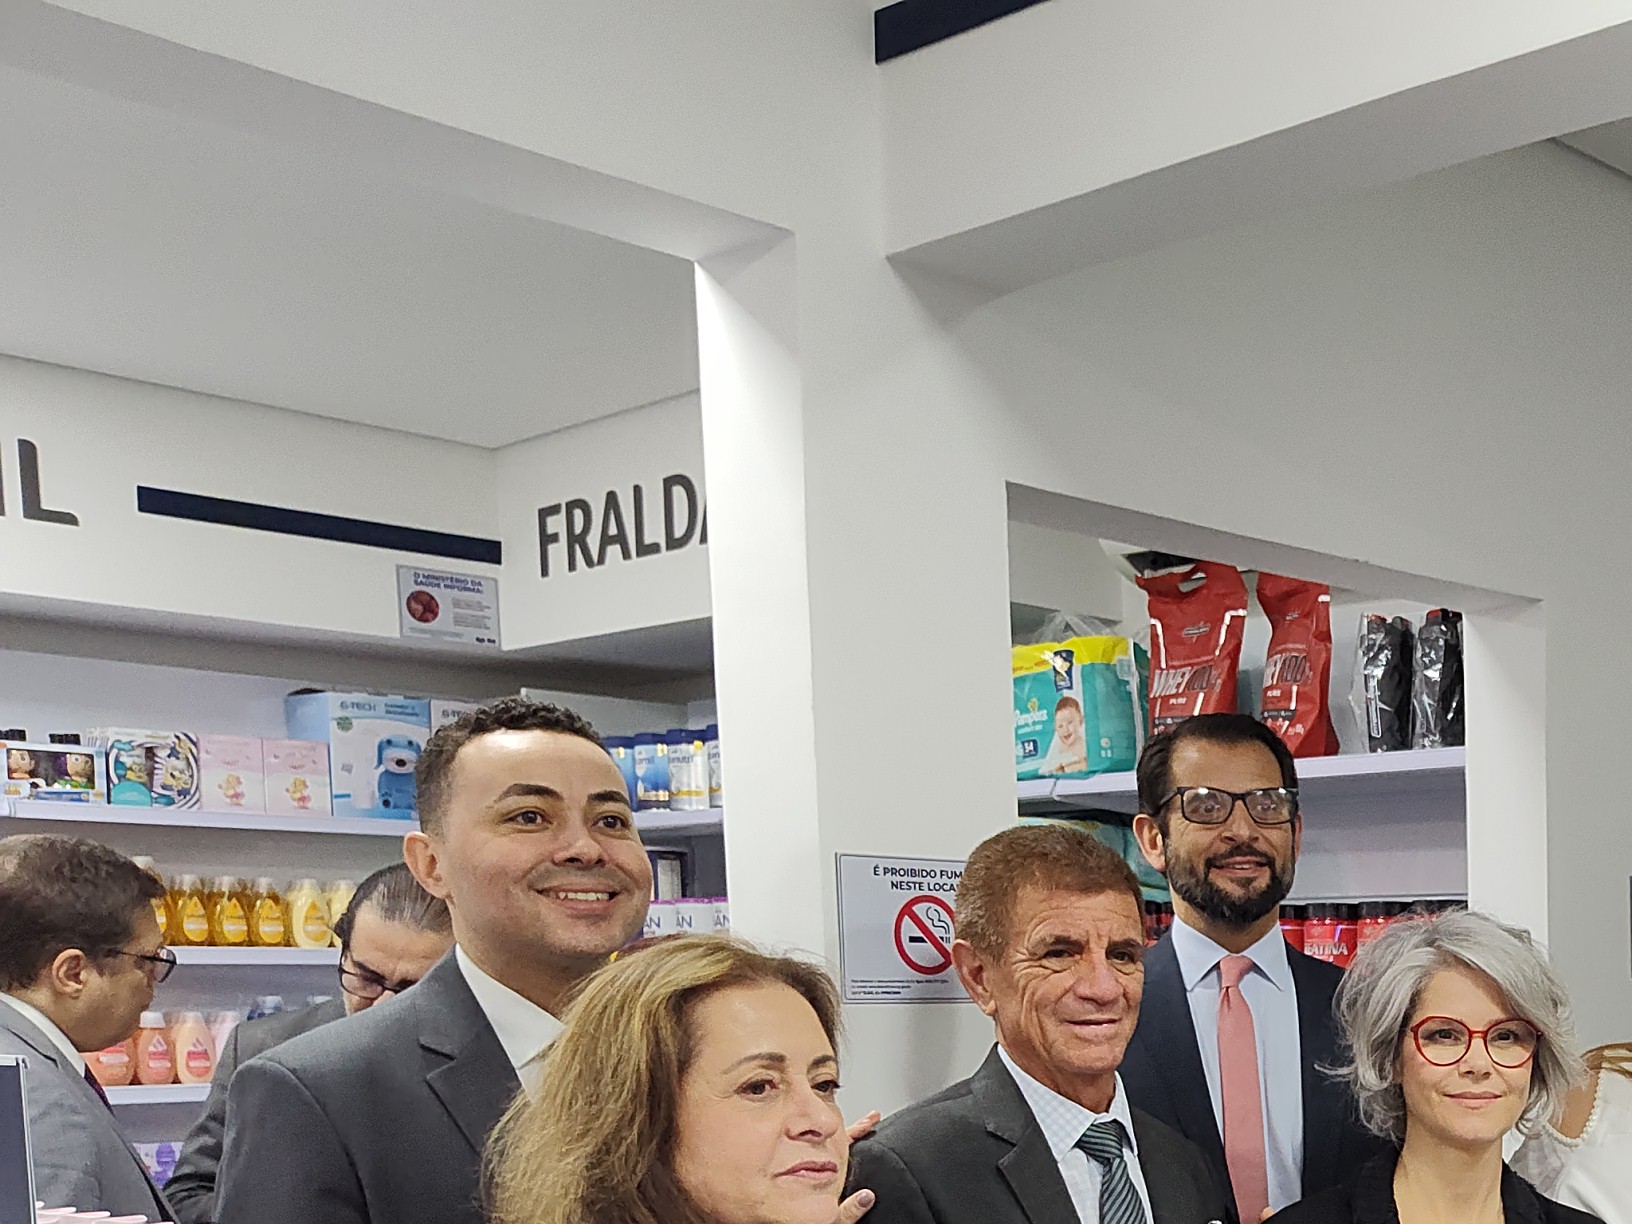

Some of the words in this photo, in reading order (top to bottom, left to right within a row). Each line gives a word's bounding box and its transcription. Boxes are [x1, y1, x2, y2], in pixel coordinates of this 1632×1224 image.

[0, 438, 79, 526] L
[1015, 709, 1048, 727] Pampers
[873, 864, 880, 876] É
[883, 867, 937, 878] PROIBIDO
[891, 881, 924, 891] NESTE
[928, 882, 958, 892] LOCA
